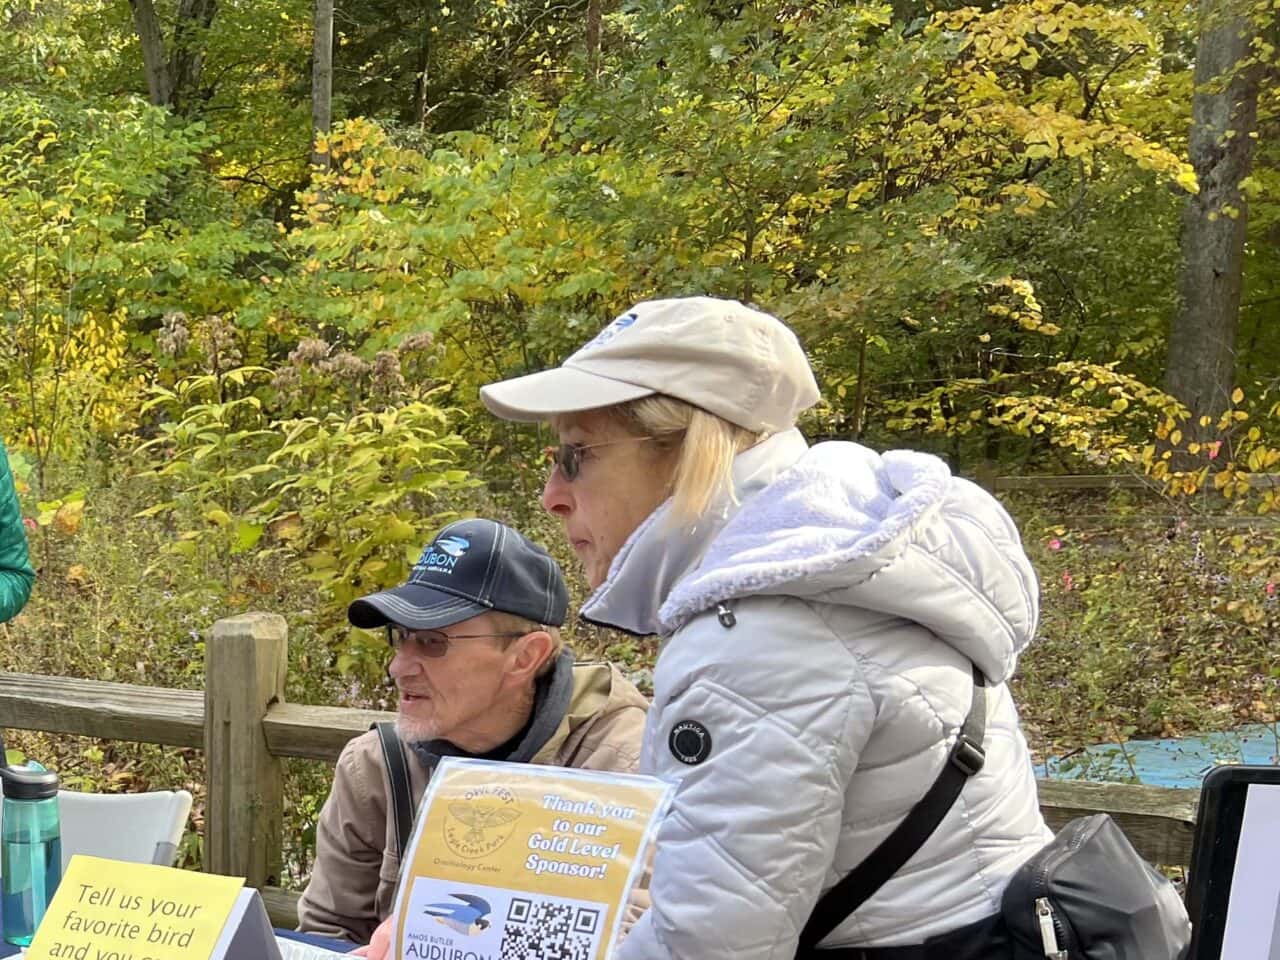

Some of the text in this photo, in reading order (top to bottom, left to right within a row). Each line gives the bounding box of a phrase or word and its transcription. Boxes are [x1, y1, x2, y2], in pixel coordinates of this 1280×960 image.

[543, 794, 636, 820] Thank you
[553, 818, 607, 836] to our
[528, 833, 620, 859] Gold Level
[525, 854, 607, 879] Sponsor!
[78, 884, 202, 919] Tell us your
[62, 911, 195, 948] favorite bird
[408, 933, 453, 946] AMOS BUTLER
[49, 942, 91, 960] and
